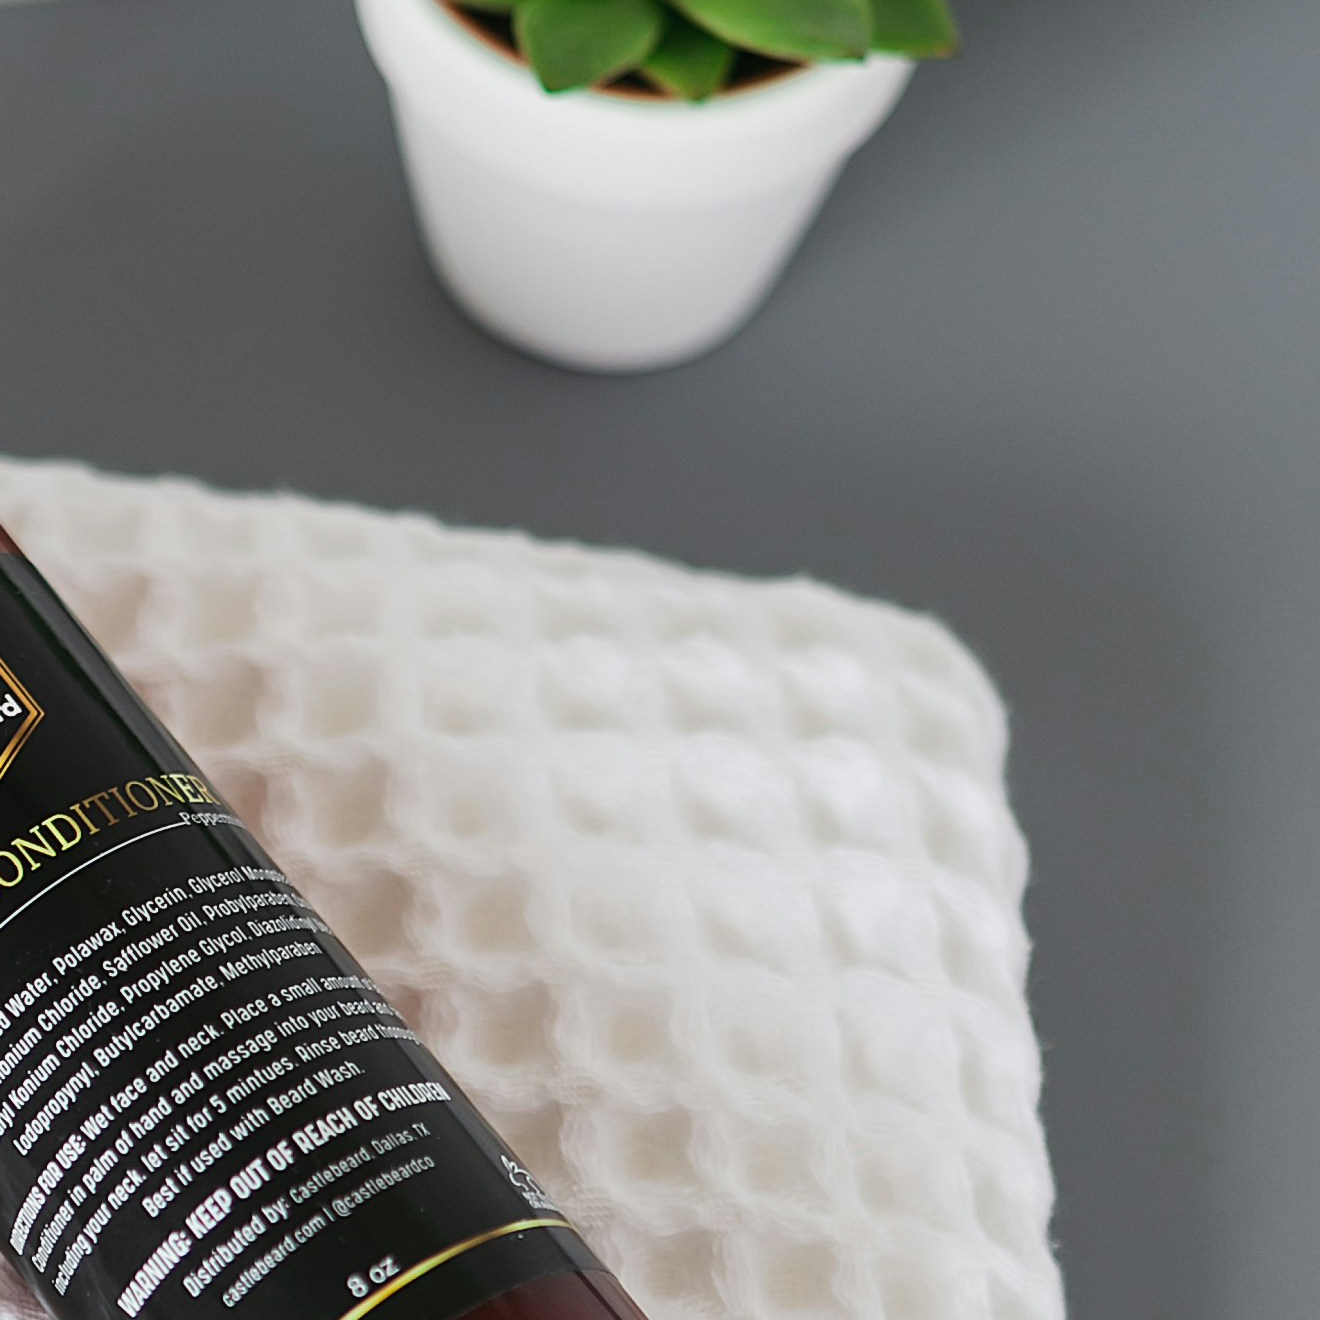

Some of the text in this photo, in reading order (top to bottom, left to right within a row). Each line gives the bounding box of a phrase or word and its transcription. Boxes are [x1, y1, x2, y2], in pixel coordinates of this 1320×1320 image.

[4, 972, 58, 1017] Water,
[52, 922, 126, 975] Polawax,
[122, 888, 192, 926] Glycerin,
[188, 868, 245, 893] Glycerol
[38, 975, 107, 1031] Chloride,
[103, 925, 178, 977] Safflower
[177, 911, 207, 931] Oil,
[93, 976, 223, 1067] Butylcarbamate,
[219, 942, 322, 981] Methylparaben
[8, 1054, 60, 1109] Konium
[56, 1002, 125, 1057] Chloride,
[120, 949, 201, 1004] Propylene
[10, 1186, 46, 1255] DIRECTIONS
[37, 1161, 63, 1195] FOR
[56, 1134, 86, 1169] USE:
[80, 1105, 115, 1140] Wet
[110, 1078, 147, 1113] face
[146, 1050, 179, 1082] and
[178, 1025, 224, 1058] neck.
[220, 999, 268, 1029] Place
[268, 994, 281, 1006] a
[281, 978, 322, 1001] small
[32, 1200, 74, 1273] Conditioner
[67, 1186, 87, 1206] in
[82, 1150, 118, 1194] palm
[115, 1130, 133, 1154] of
[129, 1096, 172, 1139] hand
[171, 1072, 204, 1104] and
[203, 1030, 277, 1080] massage
[274, 1016, 309, 1037] into
[307, 1005, 340, 1027] your
[337, 999, 375, 1015] beard
[52, 1234, 92, 1296] including
[83, 1203, 111, 1244] your
[108, 1170, 147, 1210] neck.
[141, 1144, 168, 1172] let
[165, 1125, 190, 1151] sit
[187, 1107, 212, 1132] for
[209, 1095, 226, 1113] 5
[226, 1057, 298, 1104] mintues.
[295, 1037, 341, 1062] Rinse
[338, 1025, 379, 1045] beard
[142, 1061, 364, 1217] Best if used with Beard Wash.
[117, 1082, 451, 1318] WARNING: KEEP OUT OF REACH OF CHILDREN
[183, 1215, 266, 1297] Distributed
[261, 1198, 289, 1223] by:
[412, 1122, 431, 1137] TX
[223, 1217, 325, 1307] castlebeard.com
[332, 1157, 434, 1216] @castlebeardco
[347, 1256, 400, 1297] 8 oz
